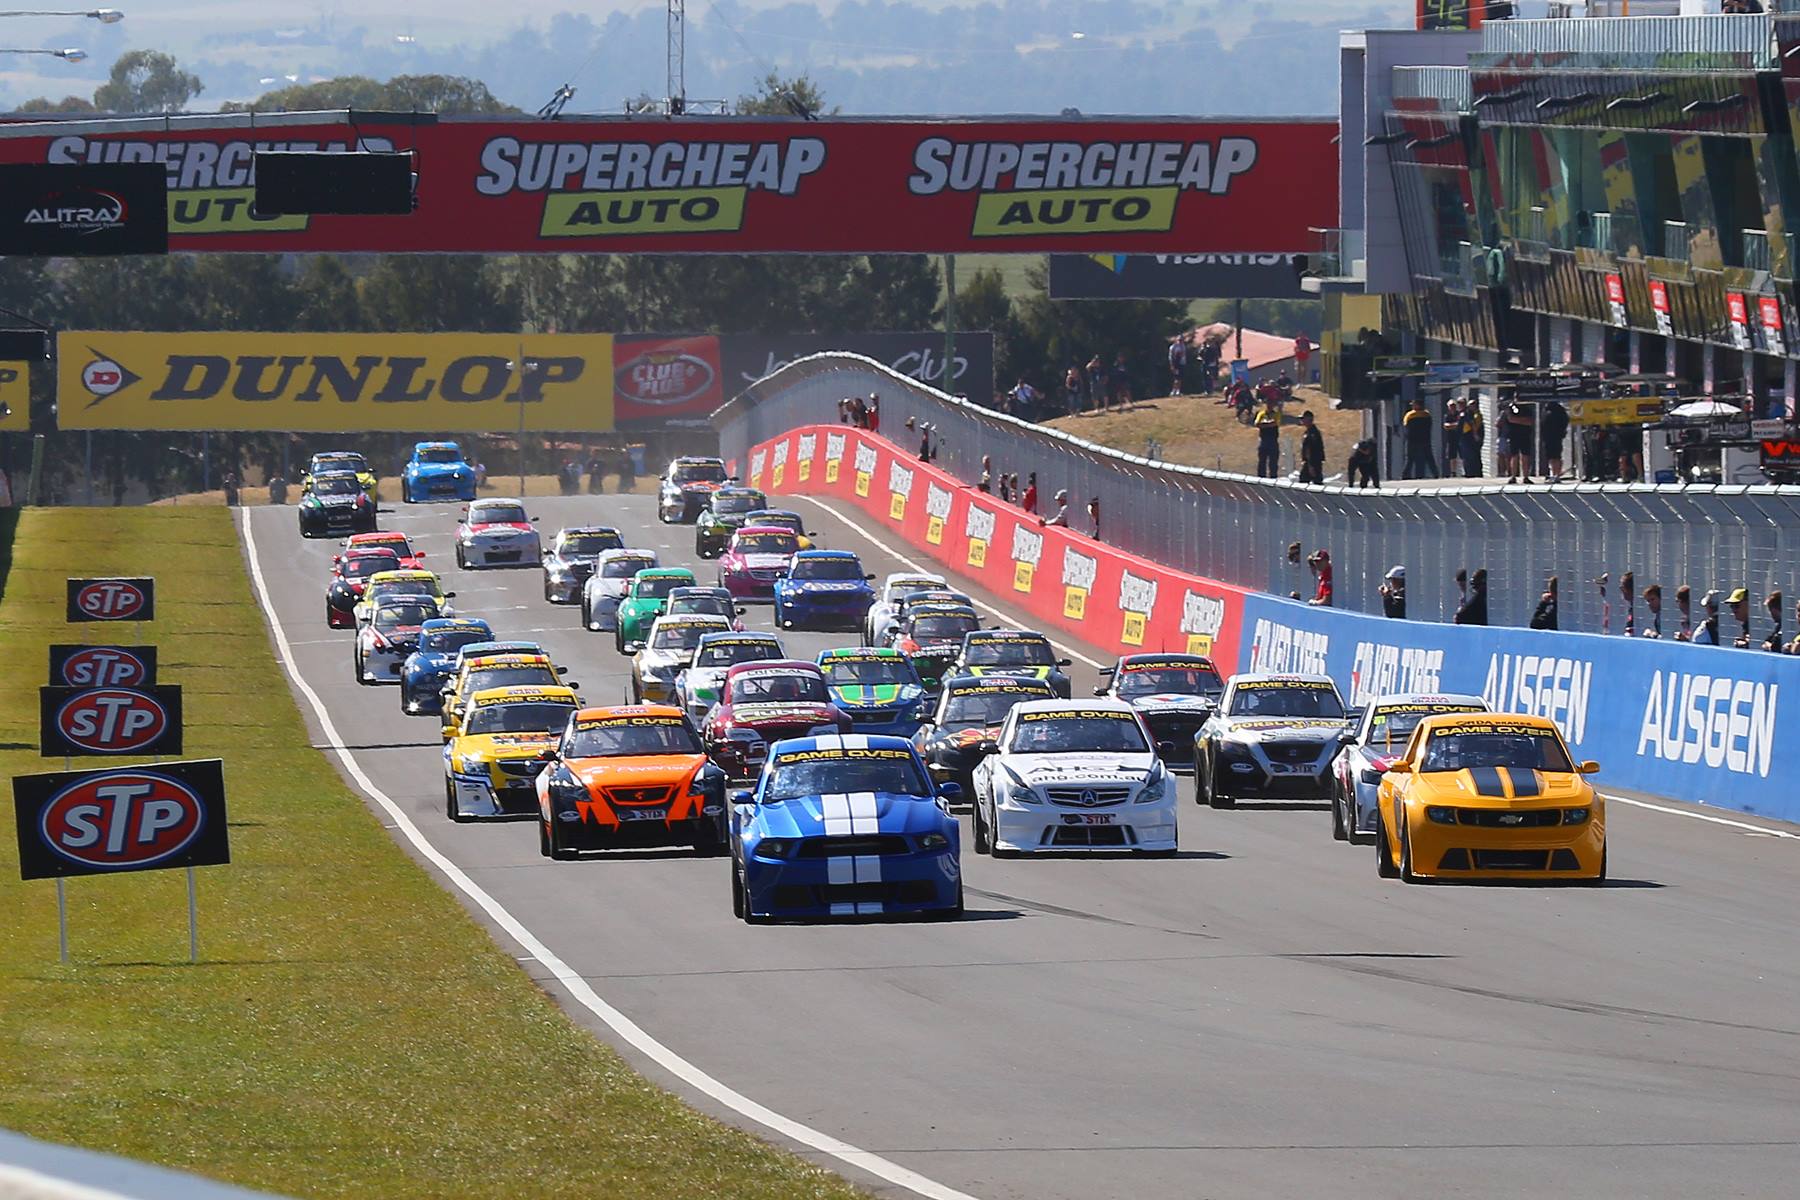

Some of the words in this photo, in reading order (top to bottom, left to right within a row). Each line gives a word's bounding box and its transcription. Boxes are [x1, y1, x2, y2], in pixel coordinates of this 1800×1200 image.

[475, 136, 827, 195] SUPERCHEAP
[907, 136, 1259, 195] SUPERCHEAP
[564, 196, 721, 227] AUTO
[997, 196, 1152, 227] AUTO
[150, 355, 586, 403] DUNLOP
[84, 585, 135, 614] STP
[72, 654, 135, 687] STP
[1125, 662, 1167, 670] GAME
[1169, 662, 1211, 670] OVER
[953, 687, 1000, 696] GAME
[1003, 686, 1050, 695] OVER
[1238, 682, 1284, 690] GAME
[1288, 682, 1333, 690] OVER
[1482, 652, 1593, 746] AUSGEN
[479, 696, 523, 706] GAME
[1023, 710, 1076, 721] GAME
[1080, 710, 1133, 720] OVER
[1377, 705, 1428, 713] GAME
[69, 697, 155, 744] STP
[577, 718, 628, 730] GAME
[632, 718, 683, 726] OVER
[1434, 726, 1493, 737] GAME
[1496, 726, 1554, 737] OVER
[1635, 669, 1779, 779] AUSGEN
[779, 750, 843, 763] GAME
[847, 750, 910, 760] OVER
[61, 783, 185, 854] STP
[1086, 815, 1112, 824] STIX
